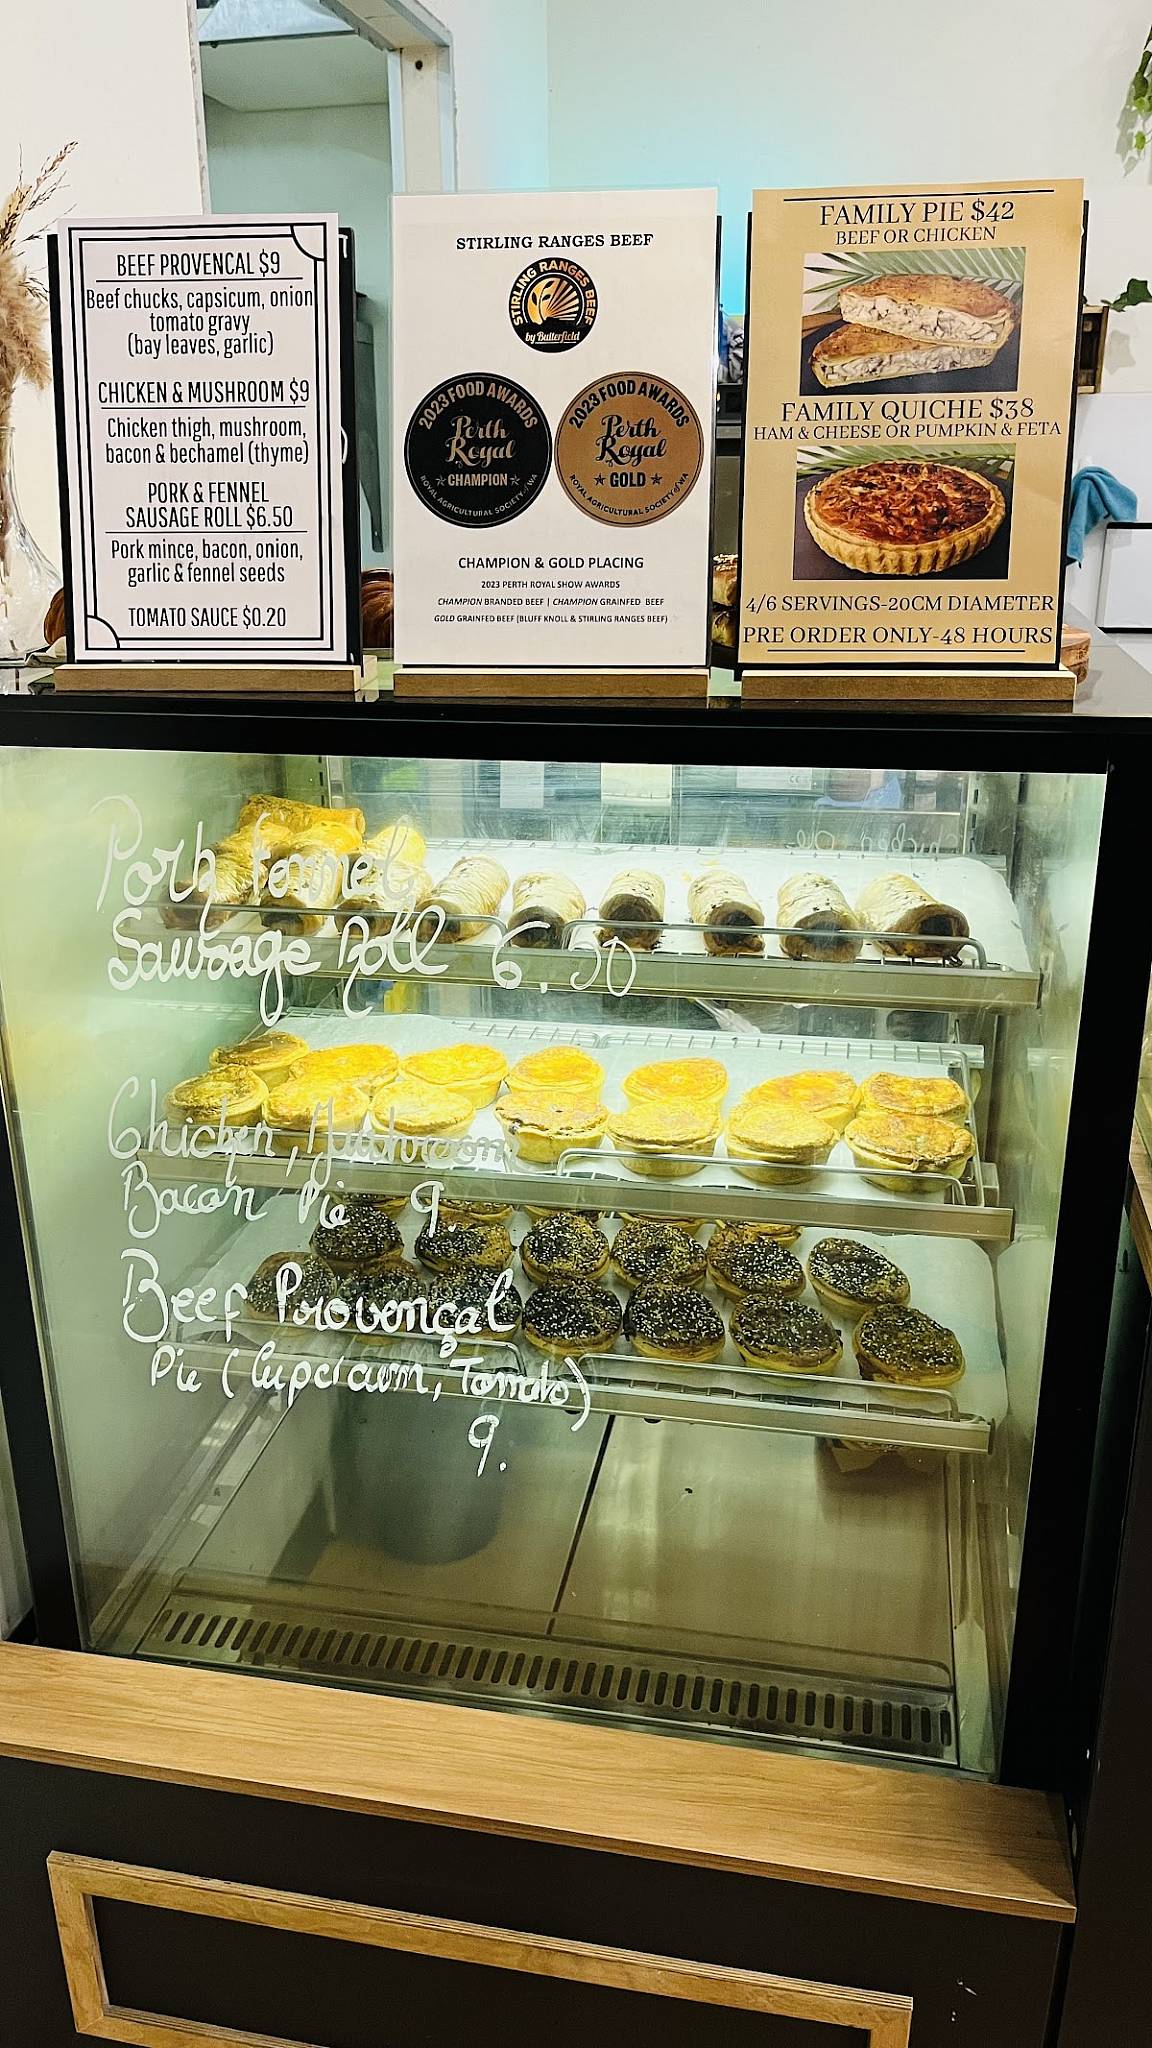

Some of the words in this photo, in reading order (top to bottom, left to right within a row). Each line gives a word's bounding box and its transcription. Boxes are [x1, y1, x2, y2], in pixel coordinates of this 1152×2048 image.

[820, 203, 916, 226] FAMILY
[922, 202, 963, 222] PIE
[971, 200, 1015, 222] $42
[456, 237, 533, 250] STIRLING
[538, 235, 604, 248] RANGES
[610, 234, 653, 247] BEEF
[836, 230, 879, 245] BEEF
[884, 229, 909, 243] OR
[914, 226, 997, 242] CHICKEN
[117, 253, 155, 276] BEEF
[160, 252, 254, 276] PROVENCAL
[259, 249, 280, 277] $9
[86, 288, 120, 309] Beef
[124, 288, 183, 310] chucks,
[187, 288, 265, 311] capsicum,
[270, 286, 313, 306] onion
[511, 268, 537, 326] STIRLING
[539, 260, 590, 287] RANGES
[585, 289, 596, 325] BEEF
[150, 314, 203, 332] tomato
[208, 314, 250, 336] gravy
[128, 333, 161, 359] (bay
[166, 332, 220, 356] leaves,
[224, 331, 274, 358] garlic)
[526, 332, 535, 344] by
[99, 381, 166, 403] CHICKEN
[173, 382, 183, 402] &
[189, 380, 284, 403] MUSHROOM
[289, 377, 309, 405] $9
[419, 394, 450, 429] 2023
[447, 381, 484, 402] FOOD
[486, 382, 538, 428] AWARDS
[569, 393, 600, 429] 2023
[598, 380, 636, 401] FOOD
[638, 382, 689, 427] AWARDS
[781, 400, 874, 422] FAMILY
[881, 399, 982, 422] QUICHE
[990, 397, 1034, 420] $38
[108, 418, 166, 438] Chicken
[171, 417, 215, 441] thigh,
[219, 418, 306, 438] mushroom,
[451, 416, 510, 441] Perth
[602, 415, 661, 440] Perth
[754, 426, 793, 440] HAM
[798, 426, 809, 440] &
[813, 424, 881, 439] CHEESE
[886, 424, 909, 438] OR
[915, 423, 996, 438] PUMPKIN
[1001, 423, 1012, 436] &
[1017, 421, 1061, 436] FETA
[106, 443, 150, 464] bacon
[155, 444, 165, 463] &
[170, 443, 244, 463] bechamel
[249, 441, 309, 466] (thyme)
[445, 437, 516, 468] Royal
[596, 436, 666, 467] Royal
[448, 474, 508, 486] CHAMPION
[610, 472, 646, 487] GOLD
[148, 482, 189, 503] PORK
[194, 482, 203, 503] &
[209, 482, 269, 502] FENNEL
[420, 475, 438, 499] ROYAL
[438, 497, 493, 516] AGRICULTURAL
[495, 492, 524, 514] SOCIETY
[570, 474, 587, 498] ROYAL
[587, 496, 643, 516] AGRICULTURAL
[644, 490, 674, 513] SOCIETY
[678, 473, 688, 485] WA
[126, 507, 199, 528] SAUSAGE
[204, 507, 242, 527] ROLL
[246, 504, 293, 530] $6.50
[112, 540, 144, 559] Pork
[149, 539, 198, 561] mince,
[203, 539, 251, 560] bacon,
[256, 539, 302, 560] onion,
[458, 557, 530, 568] CHAMPION
[534, 557, 544, 568] &
[548, 557, 584, 568] GOLD
[588, 557, 644, 568] PLACING
[128, 564, 169, 587] garlic
[174, 564, 183, 582] &
[187, 564, 235, 582] fennel
[240, 564, 284, 582] seeds
[438, 598, 482, 606] CHAMPION
[484, 598, 523, 606] BRANDED
[526, 598, 544, 606] BEEF
[552, 598, 598, 606] CHAMPION
[600, 598, 641, 606] GRAINFED
[646, 598, 664, 606] BEEF
[745, 594, 776, 615] 4/6
[782, 595, 941, 612] SERVINGS-20CM
[947, 595, 1054, 611] DIAMETER
[128, 607, 186, 627] TOMATO
[191, 607, 238, 627] SAUCE
[243, 605, 286, 629] $0.20
[648, 615, 668, 624] BEEF)
[743, 627, 784, 643] PRE
[790, 627, 865, 644] ORDER
[873, 626, 965, 645] ONLY-48
[972, 627, 1052, 644] HOURS
[107, 906, 321, 1027] Sausage
[337, 905, 449, 1019] Roll
[122, 1160, 268, 1240] Bacon
[298, 1178, 351, 1230] Pie
[410, 1180, 457, 1238] 9.
[121, 1248, 248, 1344] Beef
[275, 1262, 516, 1359] Provençal
[151, 1344, 202, 1394] Pie
[447, 1355, 593, 1432] Tomato)
[468, 1414, 506, 1477] 9.
